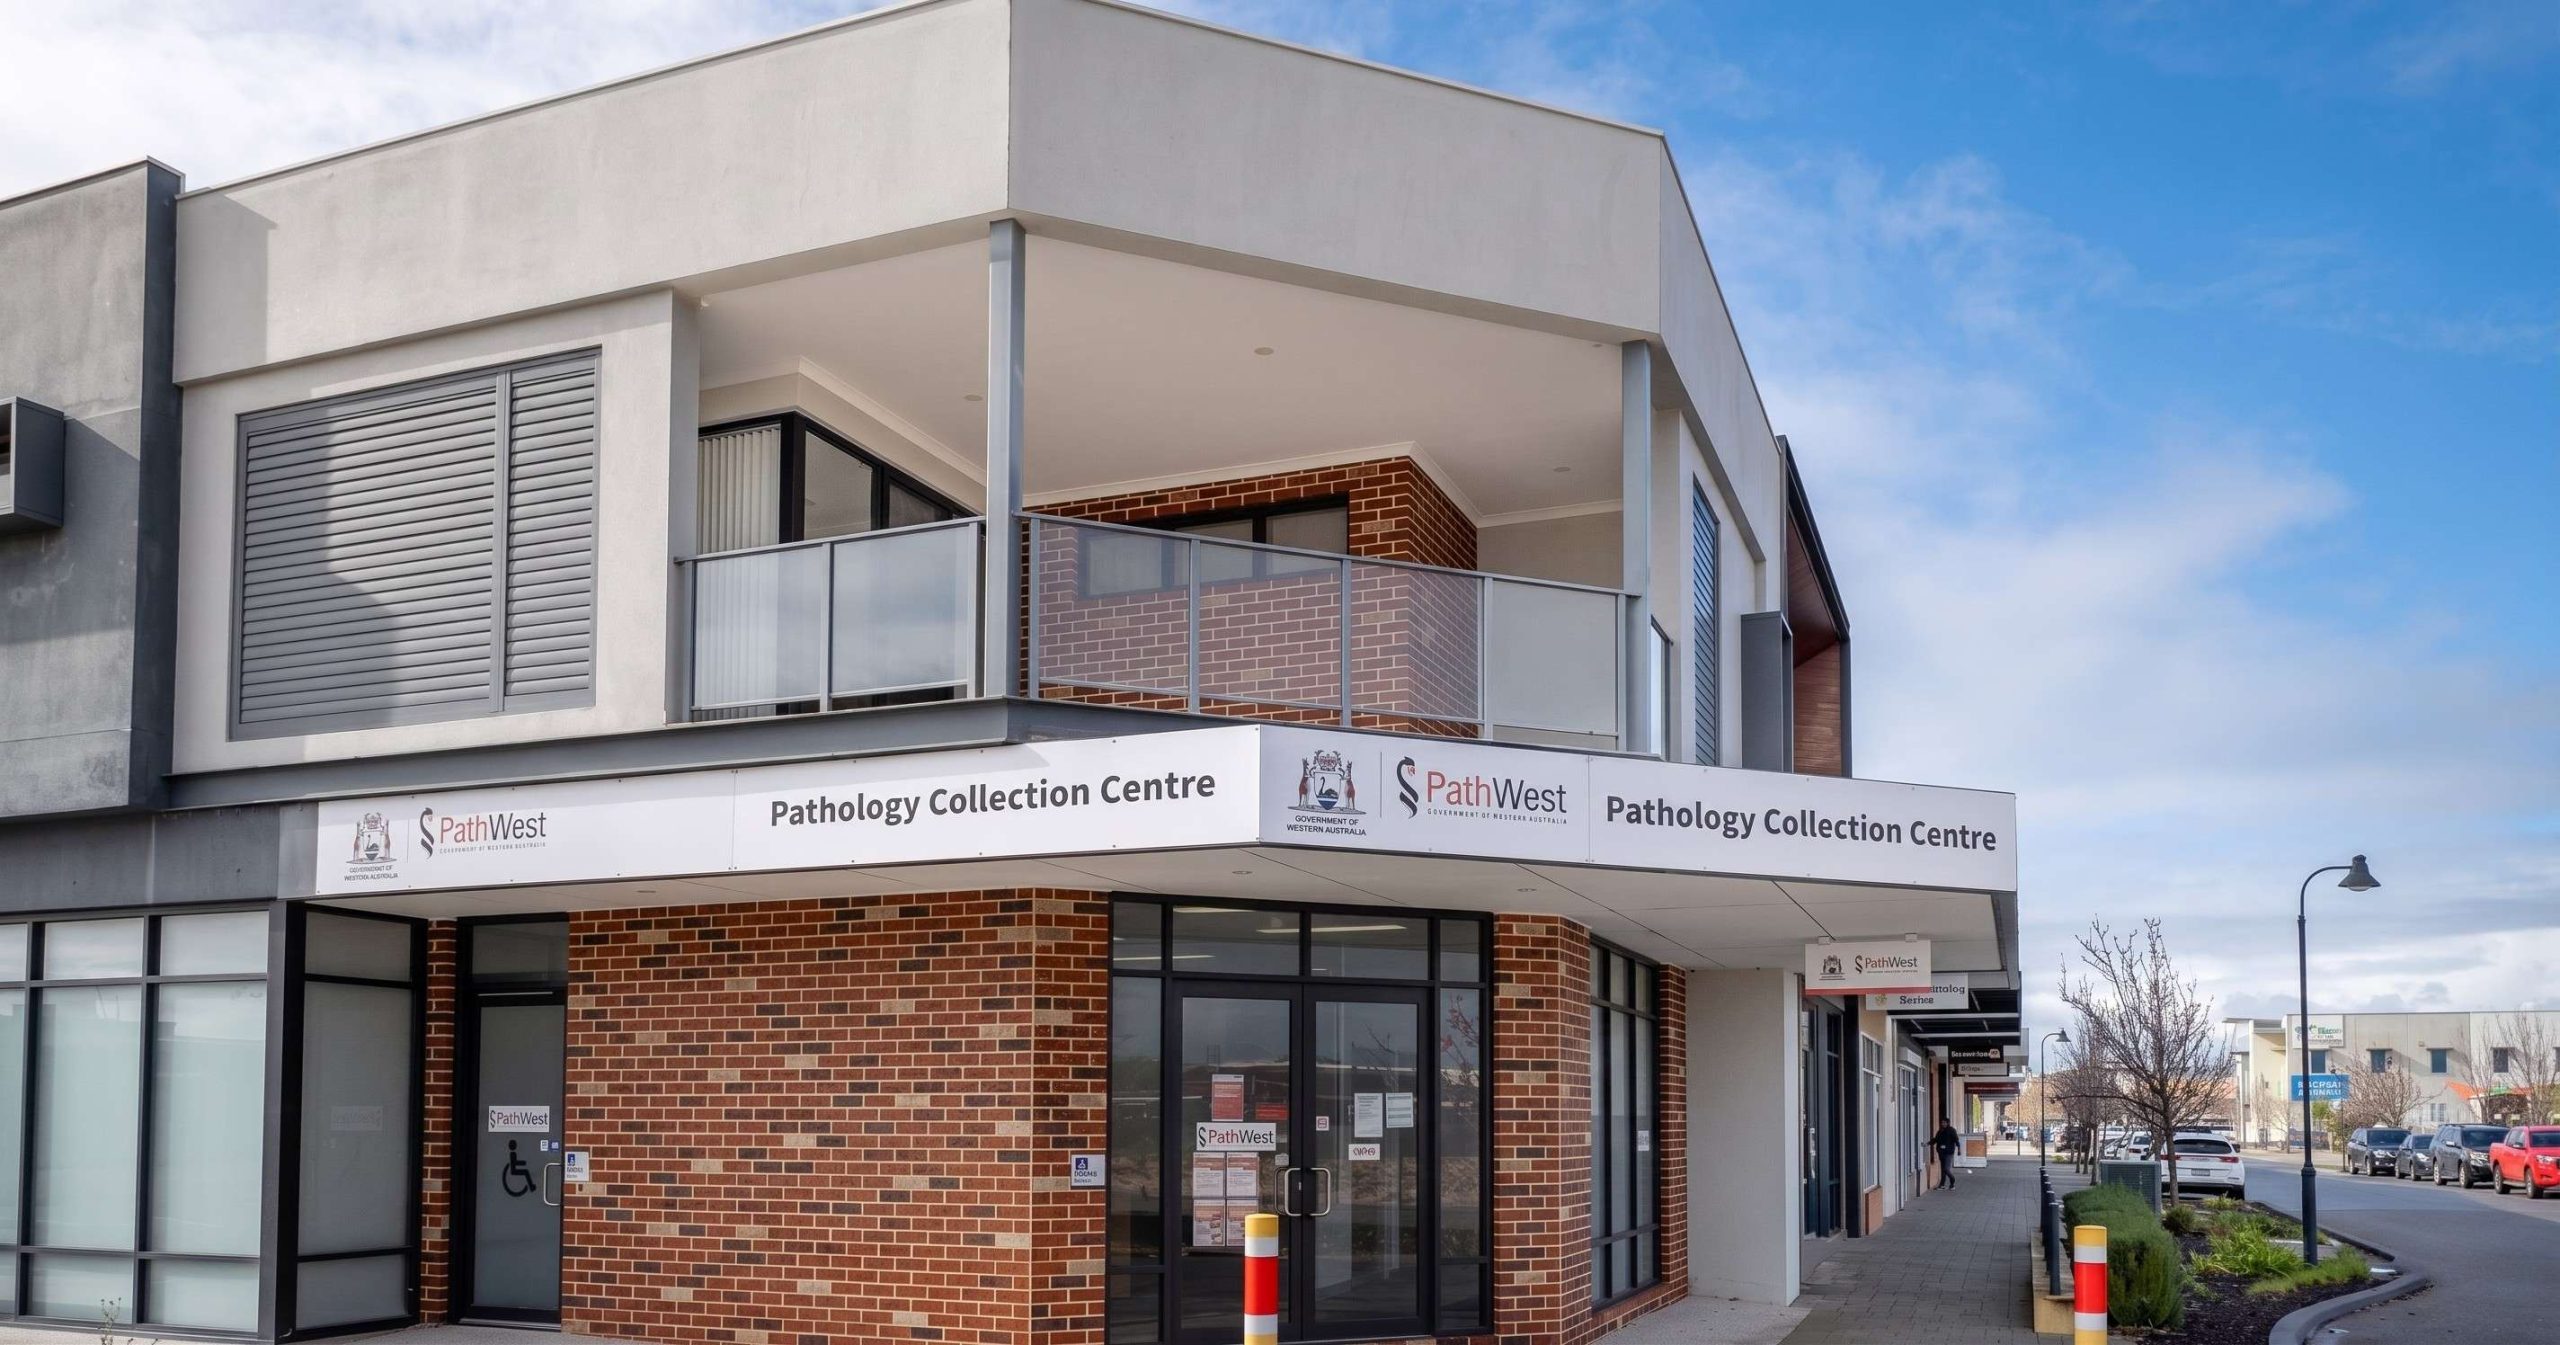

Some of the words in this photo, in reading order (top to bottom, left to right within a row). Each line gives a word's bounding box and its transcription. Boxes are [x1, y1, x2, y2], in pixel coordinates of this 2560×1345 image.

[770, 794, 920, 826] Pathology
[929, 779, 1090, 816] Collection
[1100, 772, 1217, 804] Centre
[1426, 770, 1568, 814] PathWest
[1294, 814, 1348, 825] GOVERNMENT
[1348, 818, 1359, 826] OF
[1427, 808, 1479, 818] GOVERNMENT
[1493, 813, 1527, 821] WESTERN
[1529, 816, 1567, 825] AUSTRALIA
[1606, 795, 1756, 840] Pathology
[1764, 808, 1902, 844] Collection
[1909, 820, 1997, 851] Centre
[439, 811, 547, 844] PathWest
[1286, 824, 1324, 833] WESTERN
[1325, 827, 1367, 836] AUSTRALIA
[1865, 956, 1918, 969] PathWest
[496, 1111, 549, 1126] PathWest
[1208, 1129, 1275, 1144] PathWest
